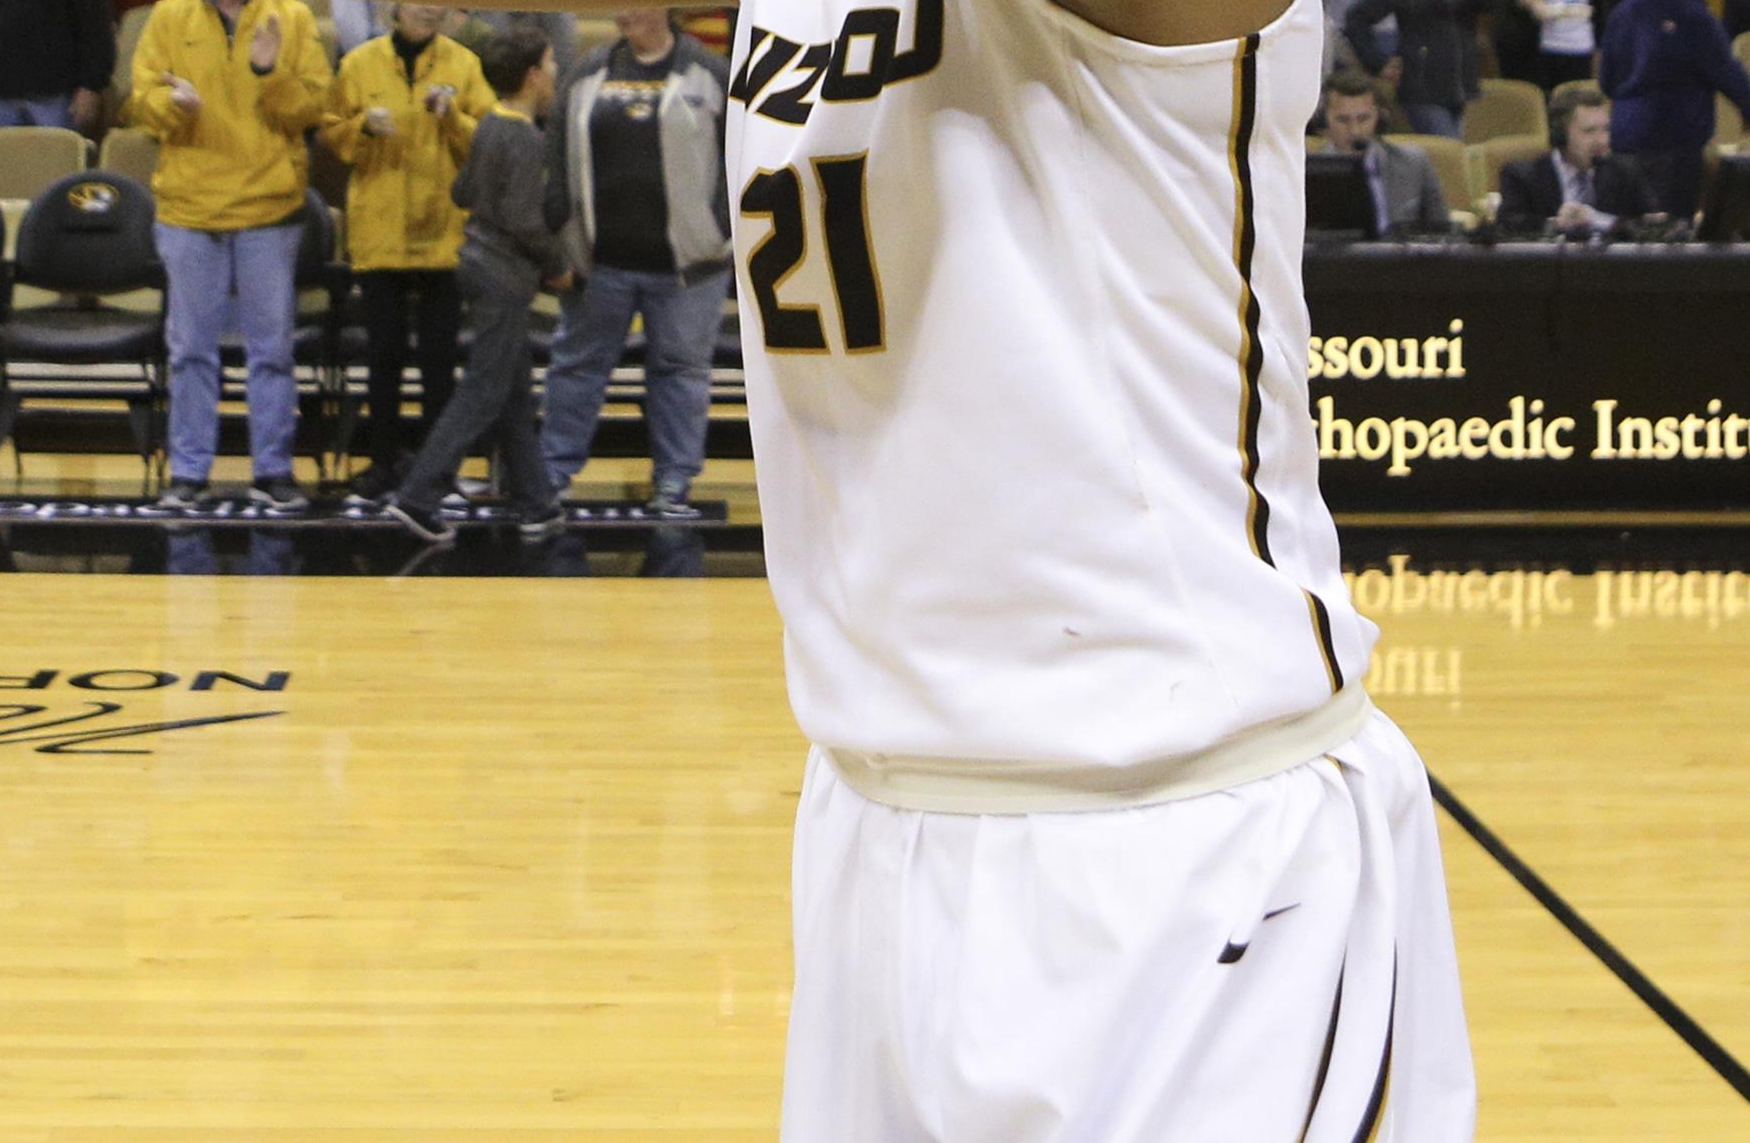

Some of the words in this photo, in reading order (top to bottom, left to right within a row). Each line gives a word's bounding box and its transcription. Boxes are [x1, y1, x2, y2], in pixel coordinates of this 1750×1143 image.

[740, 148, 887, 355] 21
[1312, 395, 1576, 476] hopaedic
[1590, 398, 1750, 460] Instit
